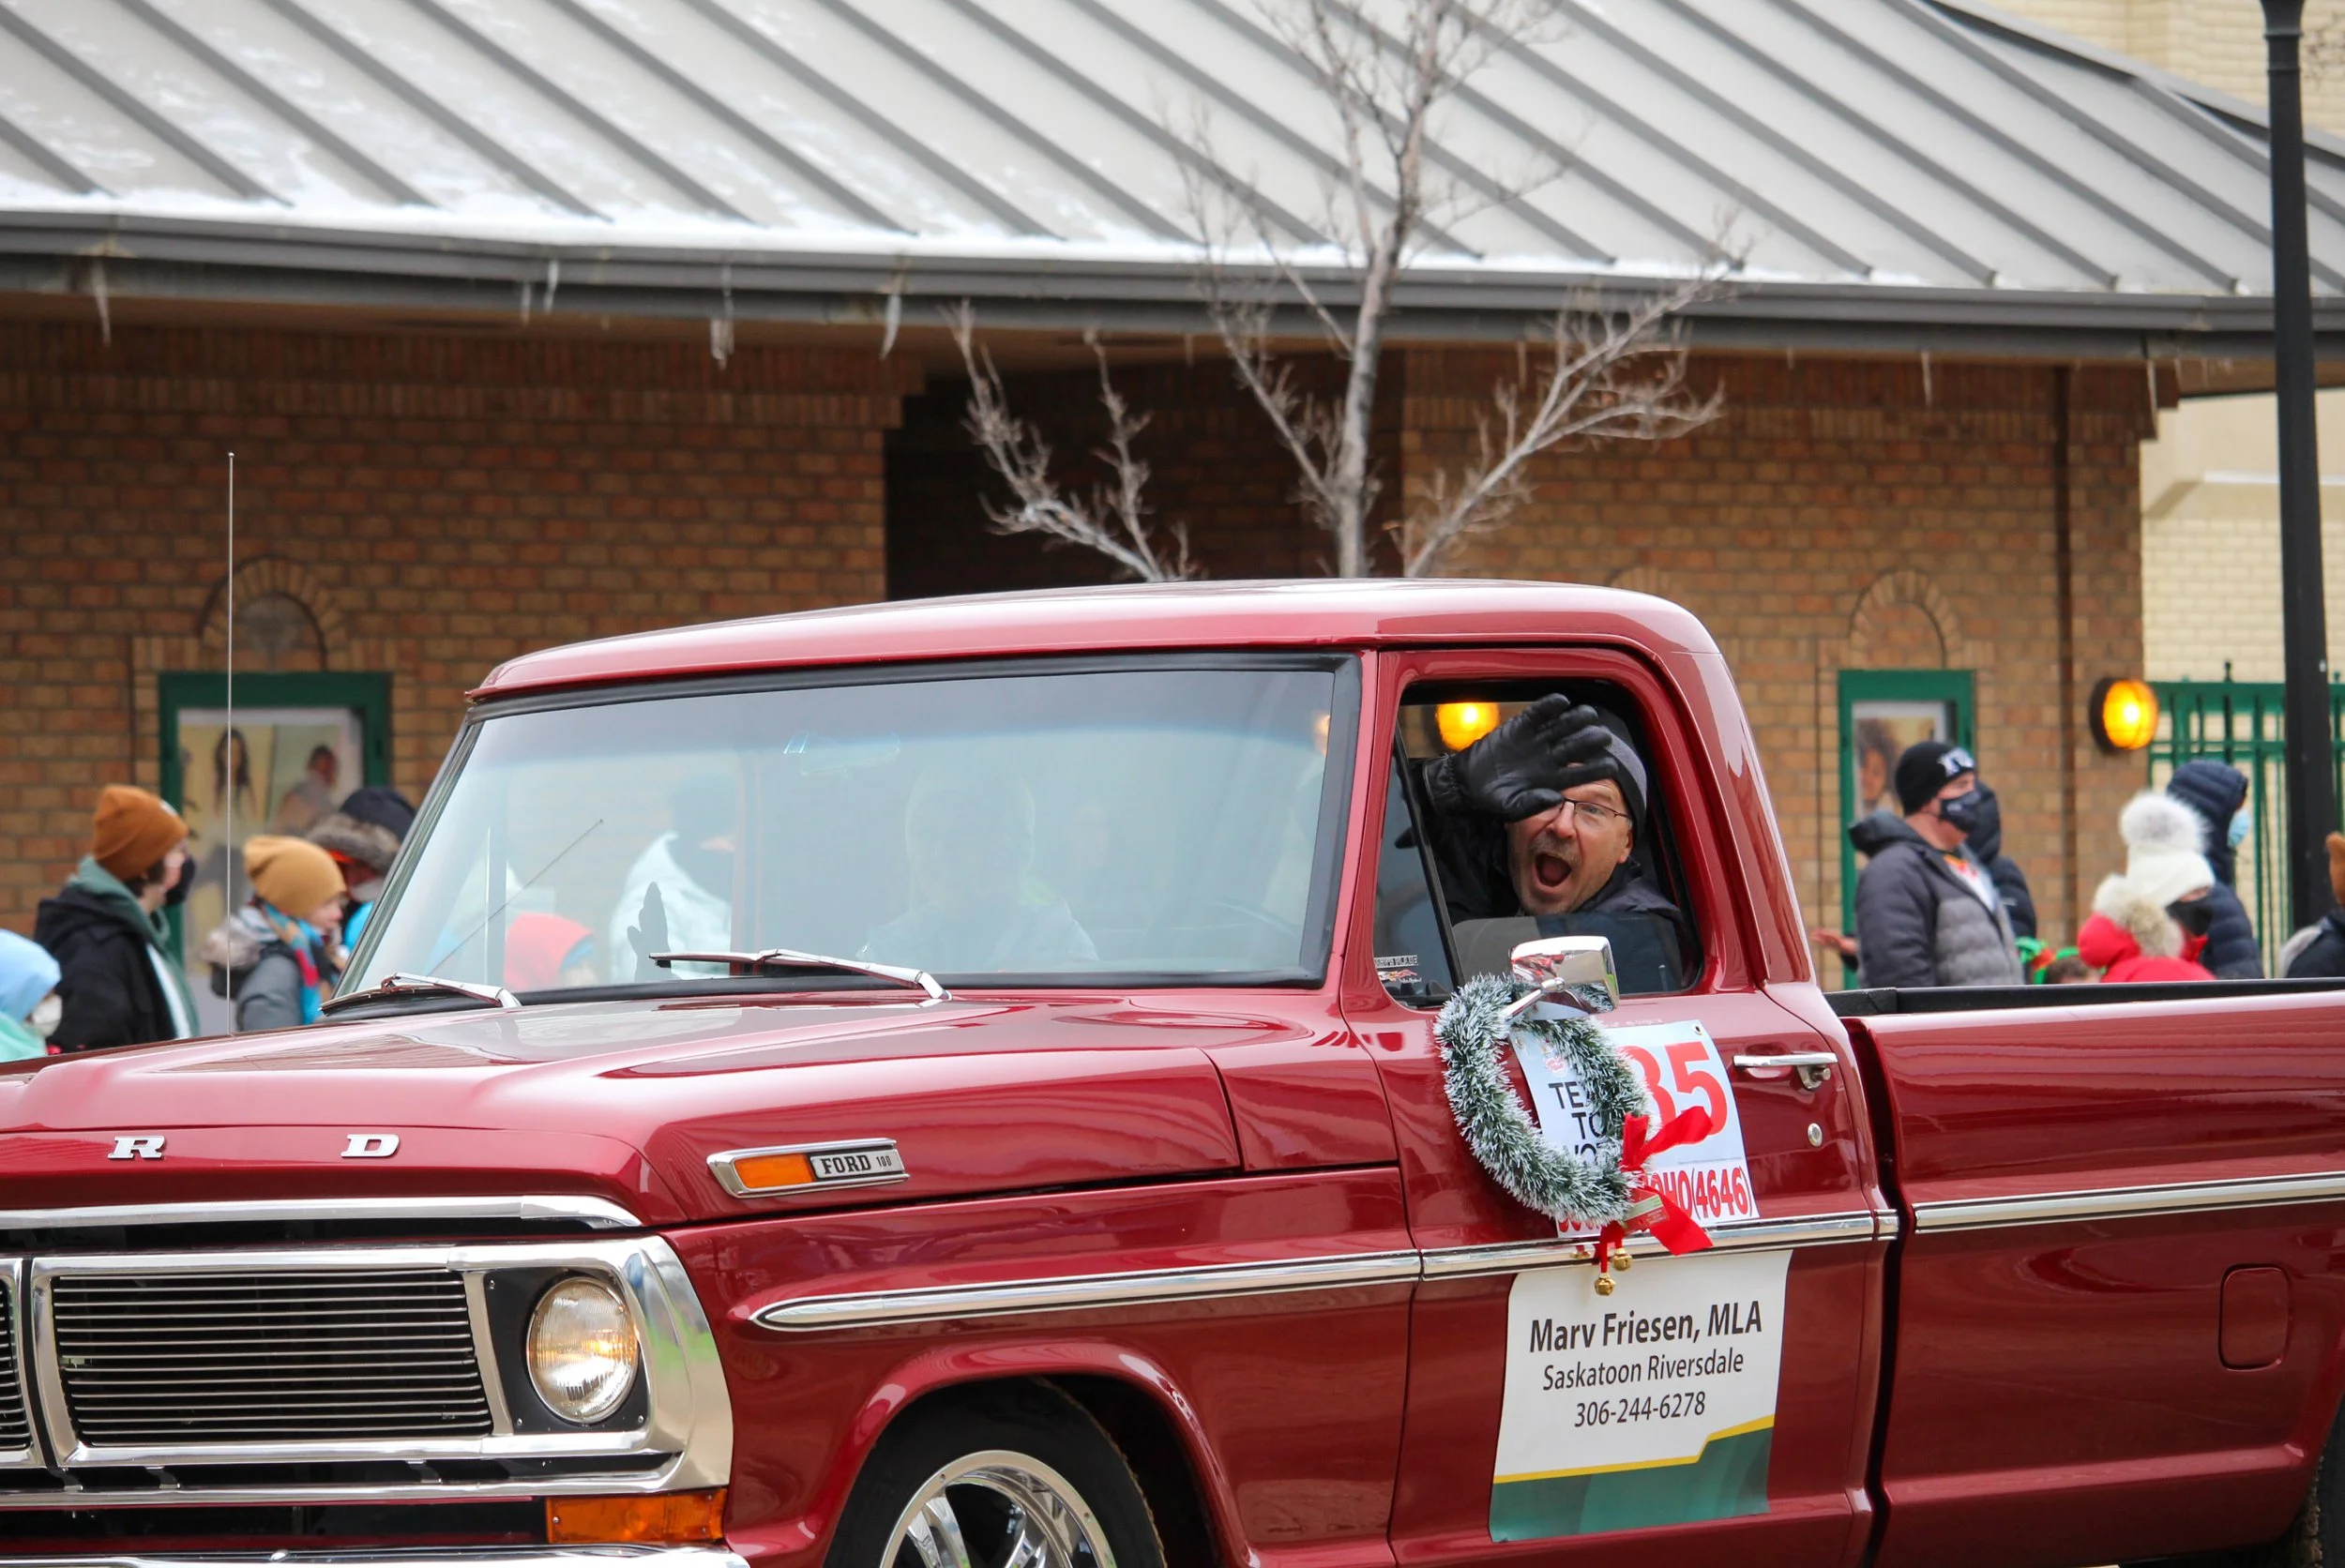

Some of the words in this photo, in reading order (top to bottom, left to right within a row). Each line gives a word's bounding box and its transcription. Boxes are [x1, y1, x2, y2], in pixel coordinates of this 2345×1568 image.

[1548, 1081, 1588, 1109] TE
[820, 1154, 872, 1175] FORD
[876, 1155, 892, 1168] 100
[1529, 1318, 1596, 1352] Marv
[1603, 1310, 1701, 1346] Friesen,
[1707, 1300, 1763, 1337] MLA
[1543, 1360, 1642, 1391] Saskatoon
[1647, 1347, 1744, 1381] Riversdale
[1574, 1391, 1706, 1427] 306-244-6278
